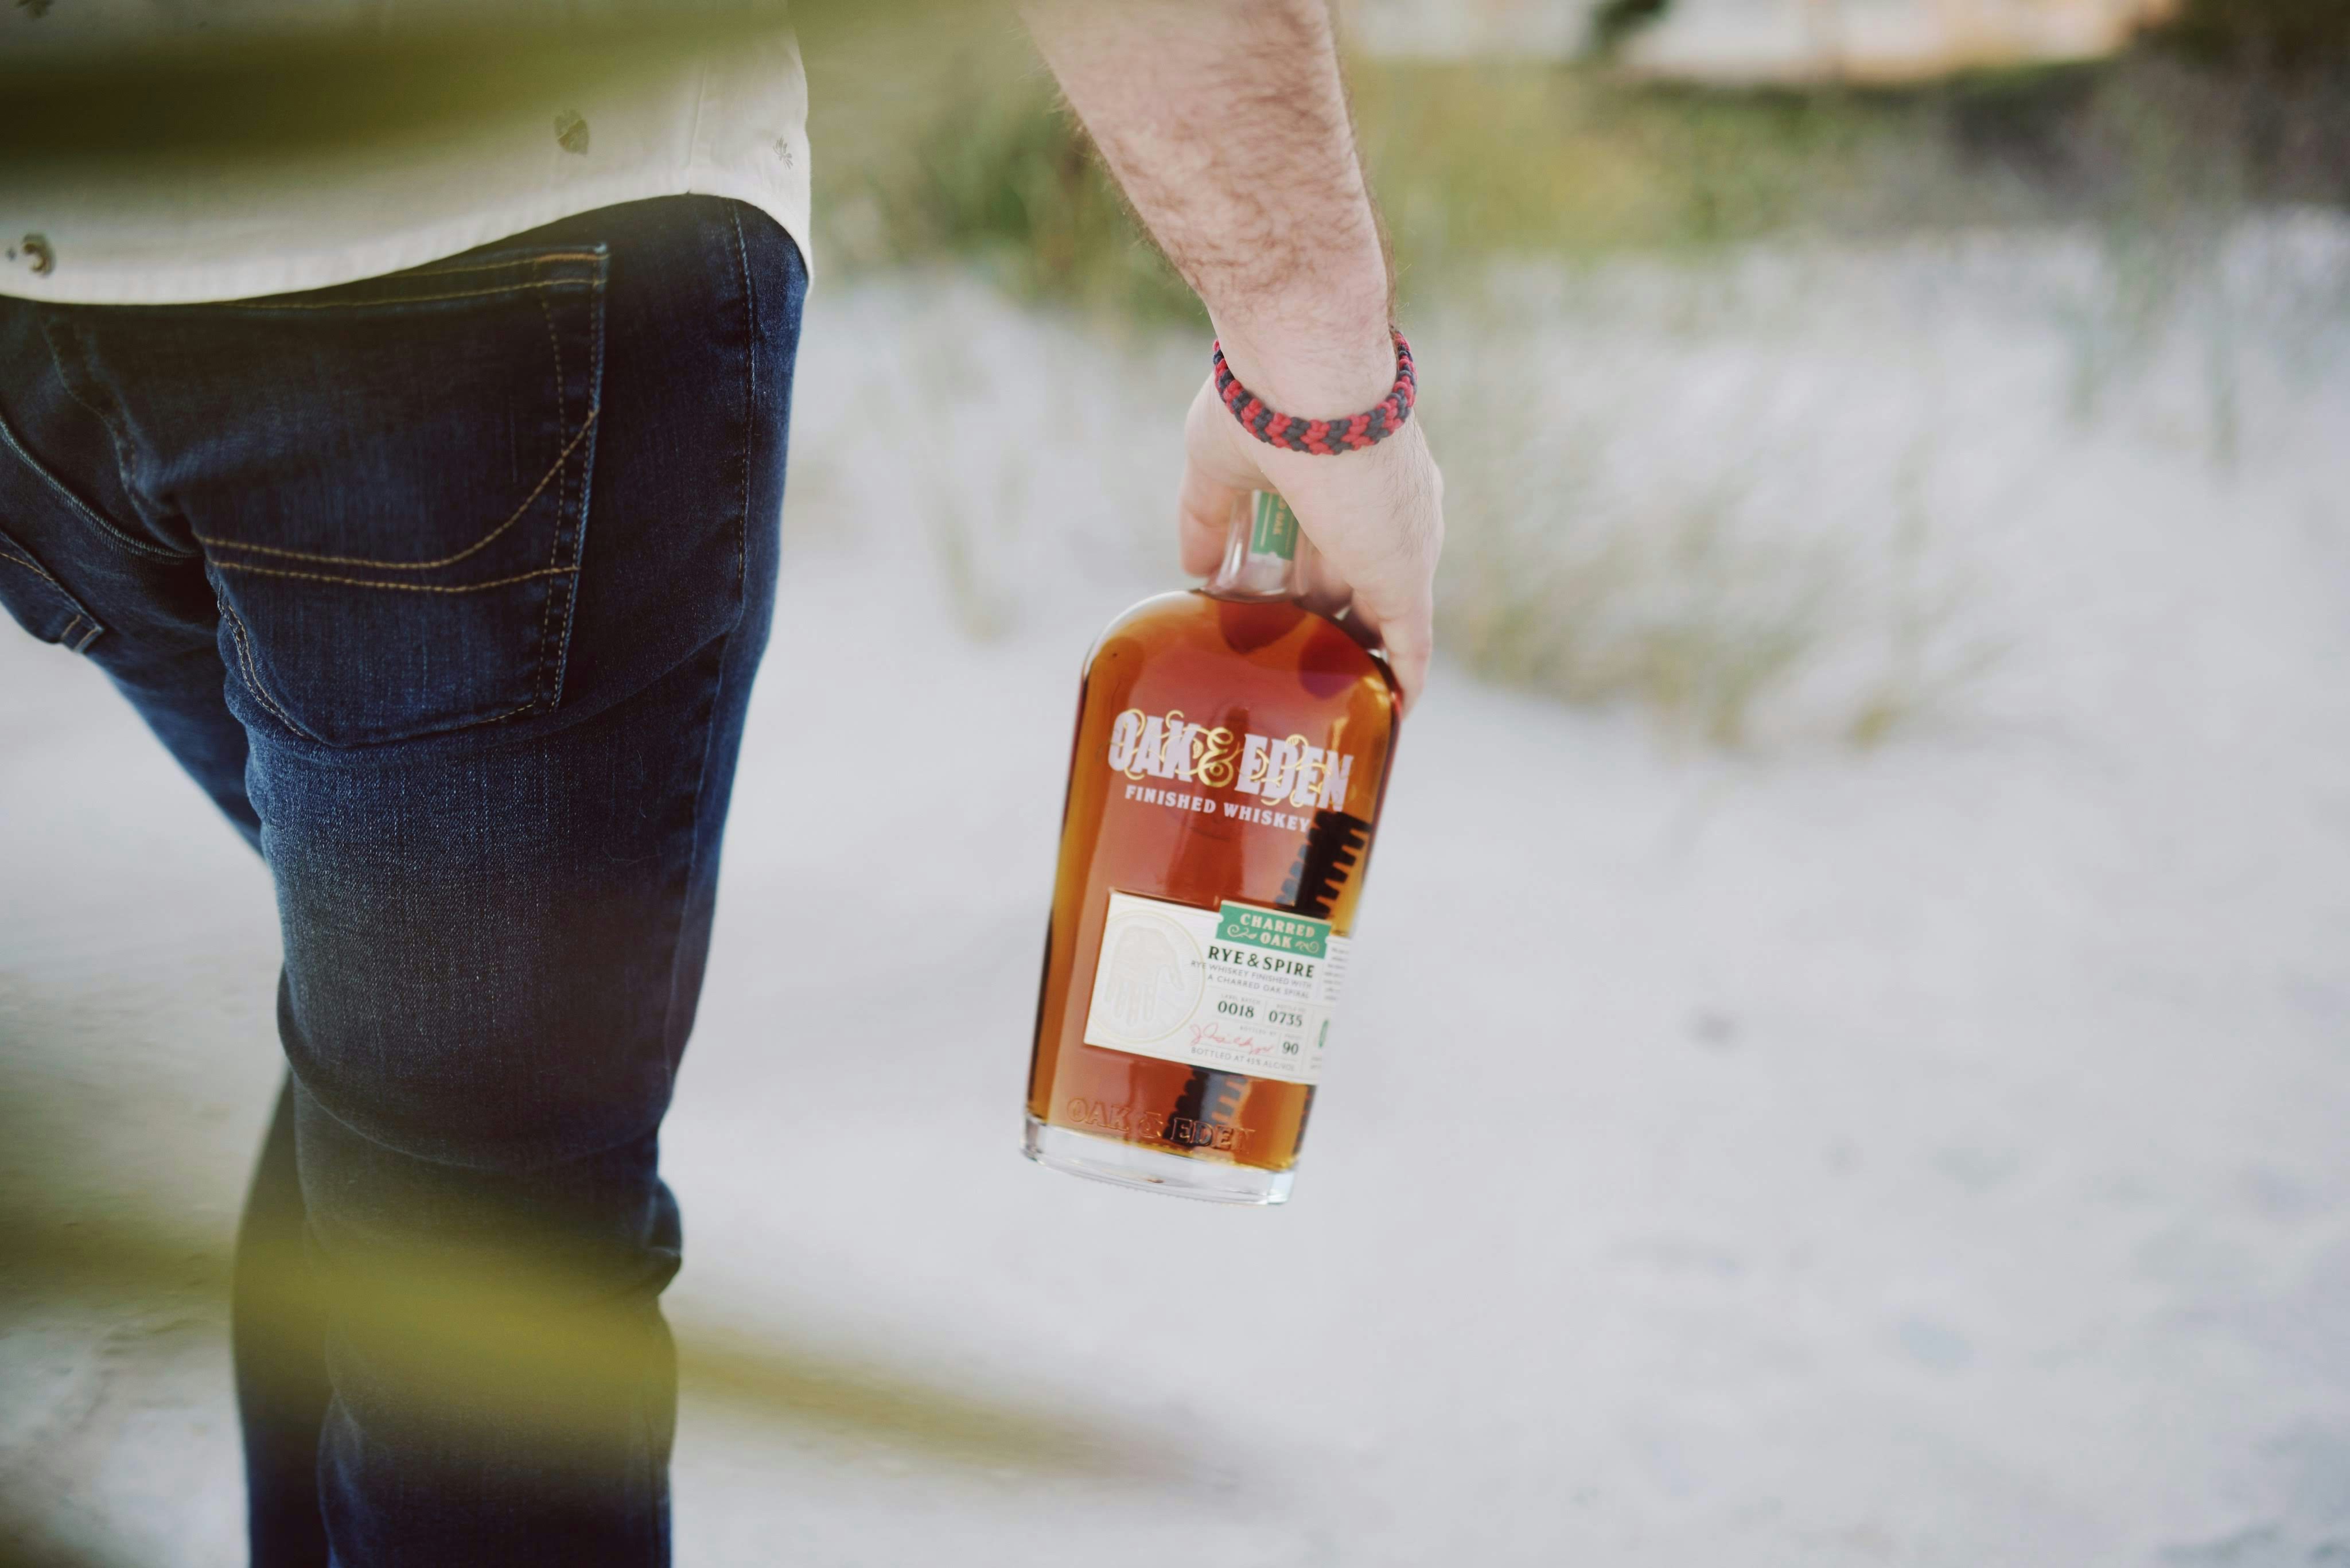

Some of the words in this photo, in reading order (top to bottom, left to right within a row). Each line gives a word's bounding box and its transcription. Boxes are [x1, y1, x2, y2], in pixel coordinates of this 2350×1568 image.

[1108, 710, 1201, 783] OAK
[1235, 734, 1354, 812] EDEN
[1125, 785, 1216, 814] FINISHED
[1224, 802, 1311, 832] WHISKEY
[1240, 913, 1316, 937] CHARRED
[1260, 932, 1291, 948] OAK
[1208, 946, 1244, 964] RYE
[1247, 954, 1259, 968] &
[1262, 956, 1315, 978] SPIRE
[1190, 960, 1207, 970] RYE
[1209, 964, 1250, 978] WHISKEY
[1251, 972, 1289, 985] FINISHED
[1291, 979, 1312, 989] WITH
[1217, 976, 1260, 990] CHARRED
[1263, 984, 1281, 994] OAK
[1284, 988, 1310, 999] SPIRAL
[1217, 1000, 1255, 1019] 0018
[1269, 1010, 1303, 1028] 0735
[1191, 1046, 1232, 1060] BOTTLED
[1282, 1041, 1299, 1055] 90
[1066, 1097, 1131, 1132] OAK
[1170, 1116, 1256, 1155] EDEN
